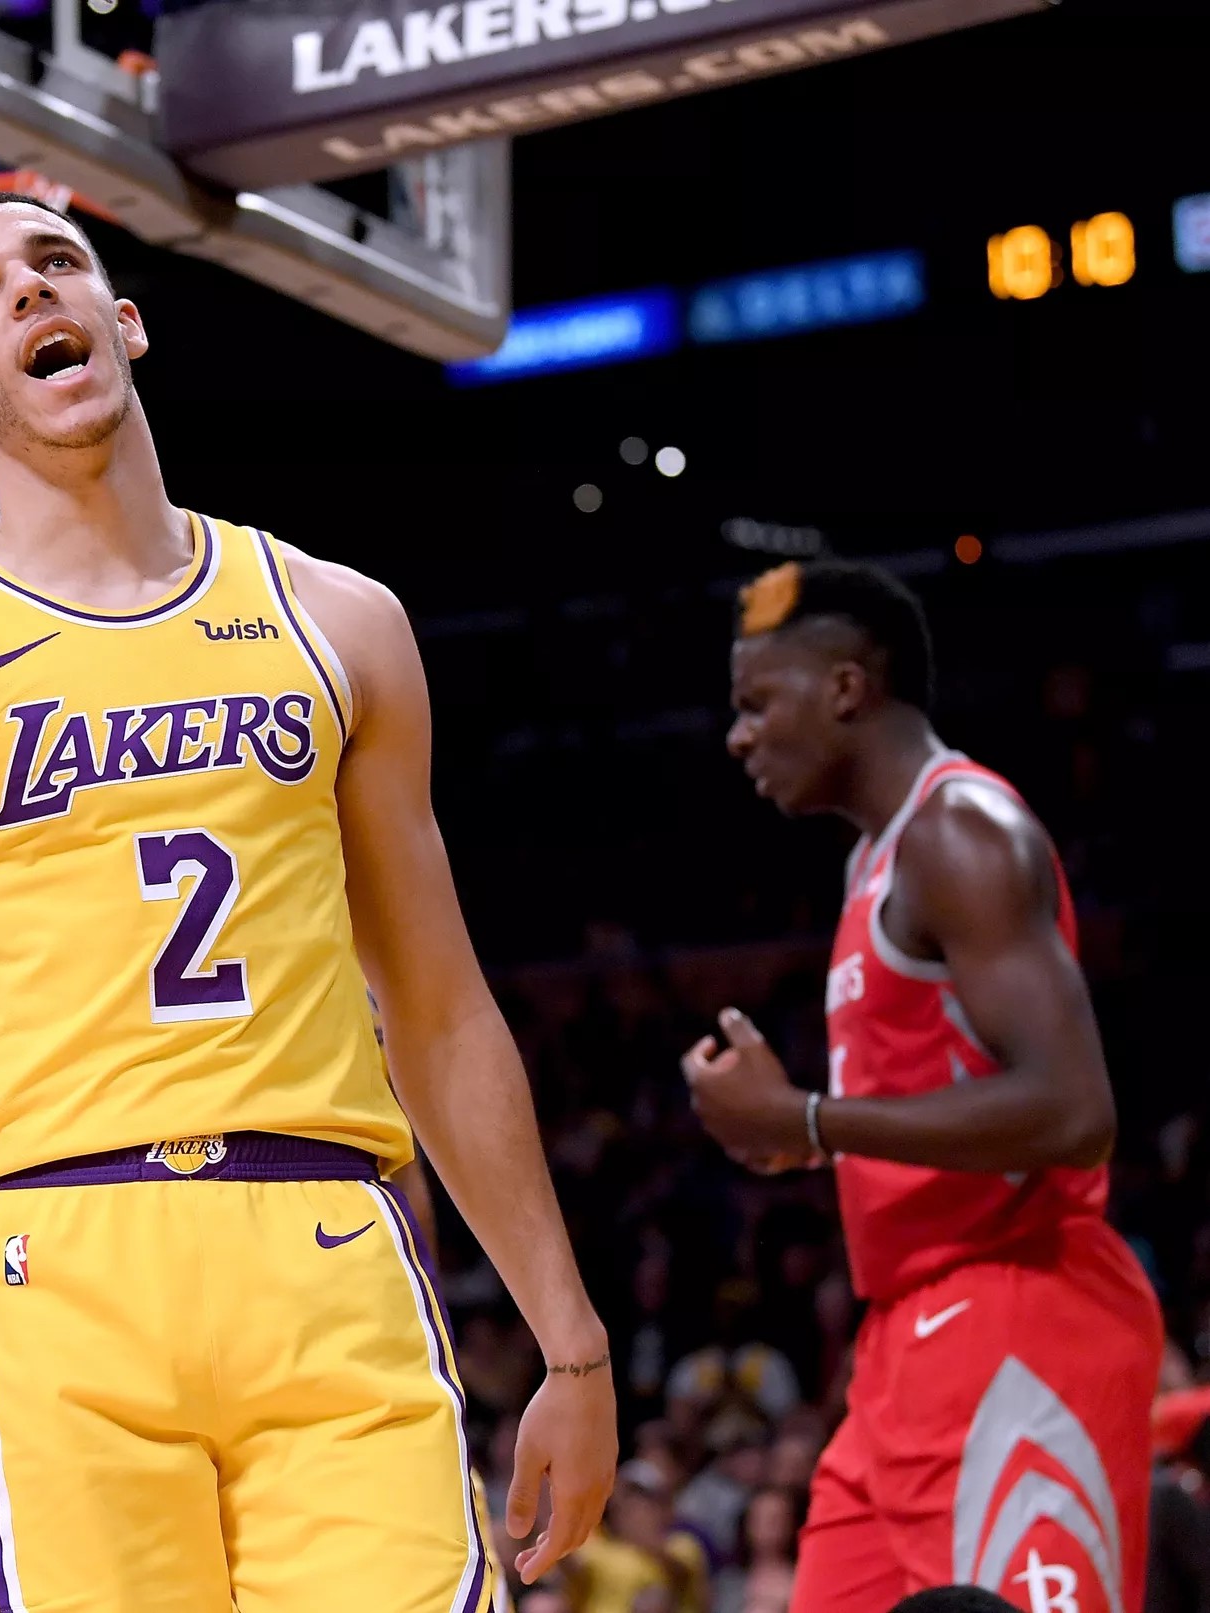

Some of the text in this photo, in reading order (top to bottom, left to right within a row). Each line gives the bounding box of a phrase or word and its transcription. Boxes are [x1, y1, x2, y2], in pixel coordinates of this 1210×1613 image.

[322, 18, 888, 164] LAKERS.COM
[194, 616, 279, 641] wish
[134, 827, 254, 1025] 2
[148, 1139, 225, 1161] LAKERS
[7, 1273, 21, 1284] NBA
